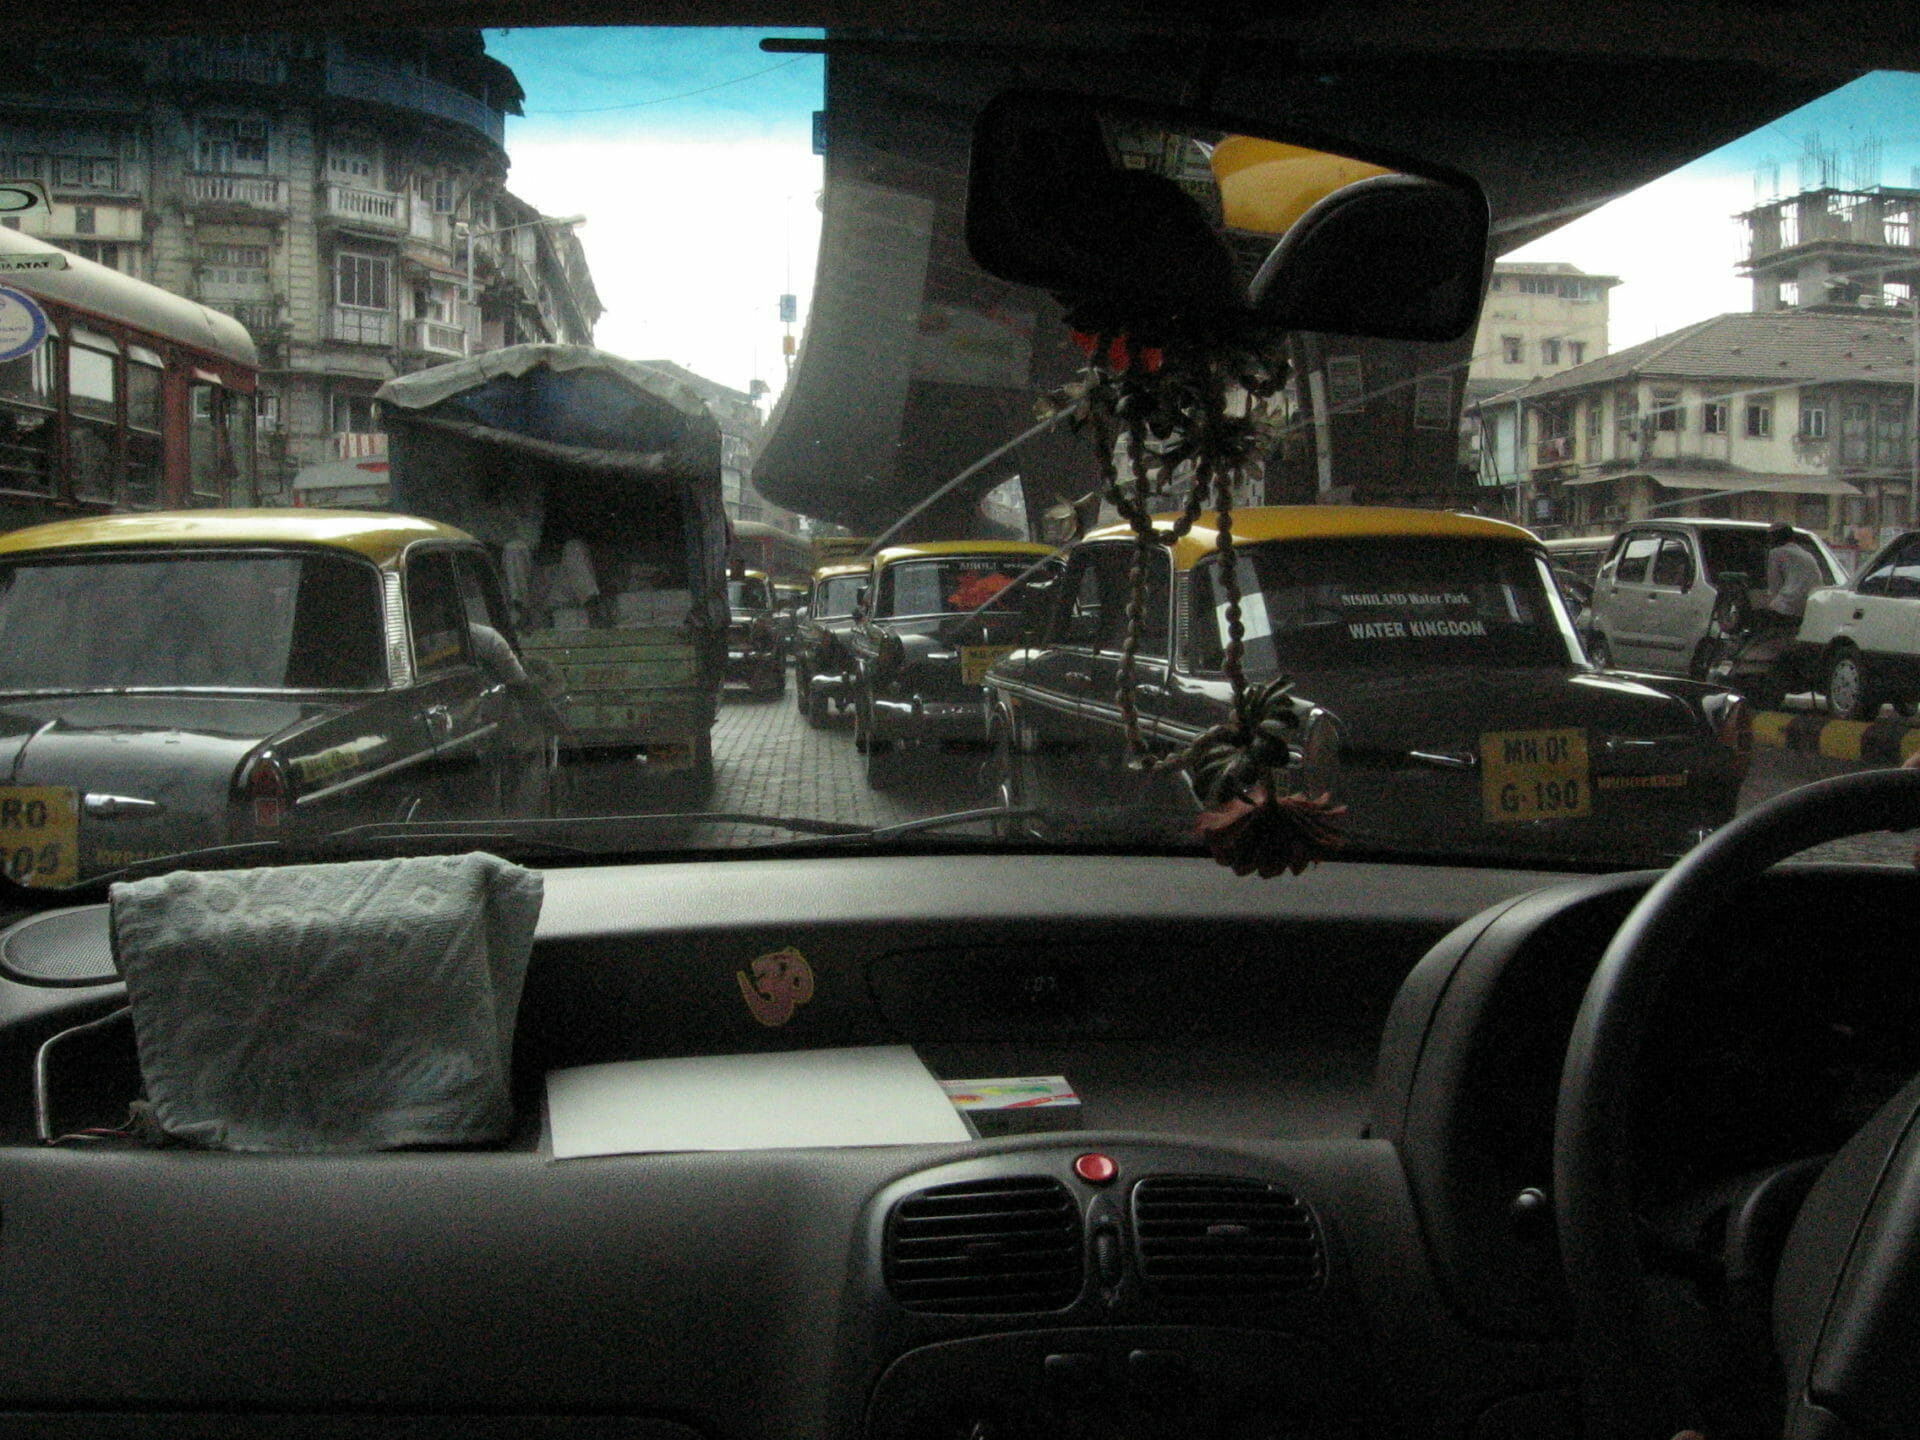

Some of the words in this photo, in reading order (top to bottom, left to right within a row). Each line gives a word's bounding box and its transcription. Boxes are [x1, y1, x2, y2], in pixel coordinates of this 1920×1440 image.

[1444, 592, 1470, 604] Park
[1349, 622, 1405, 639] WATER
[1409, 620, 1487, 637] KINGDOM
